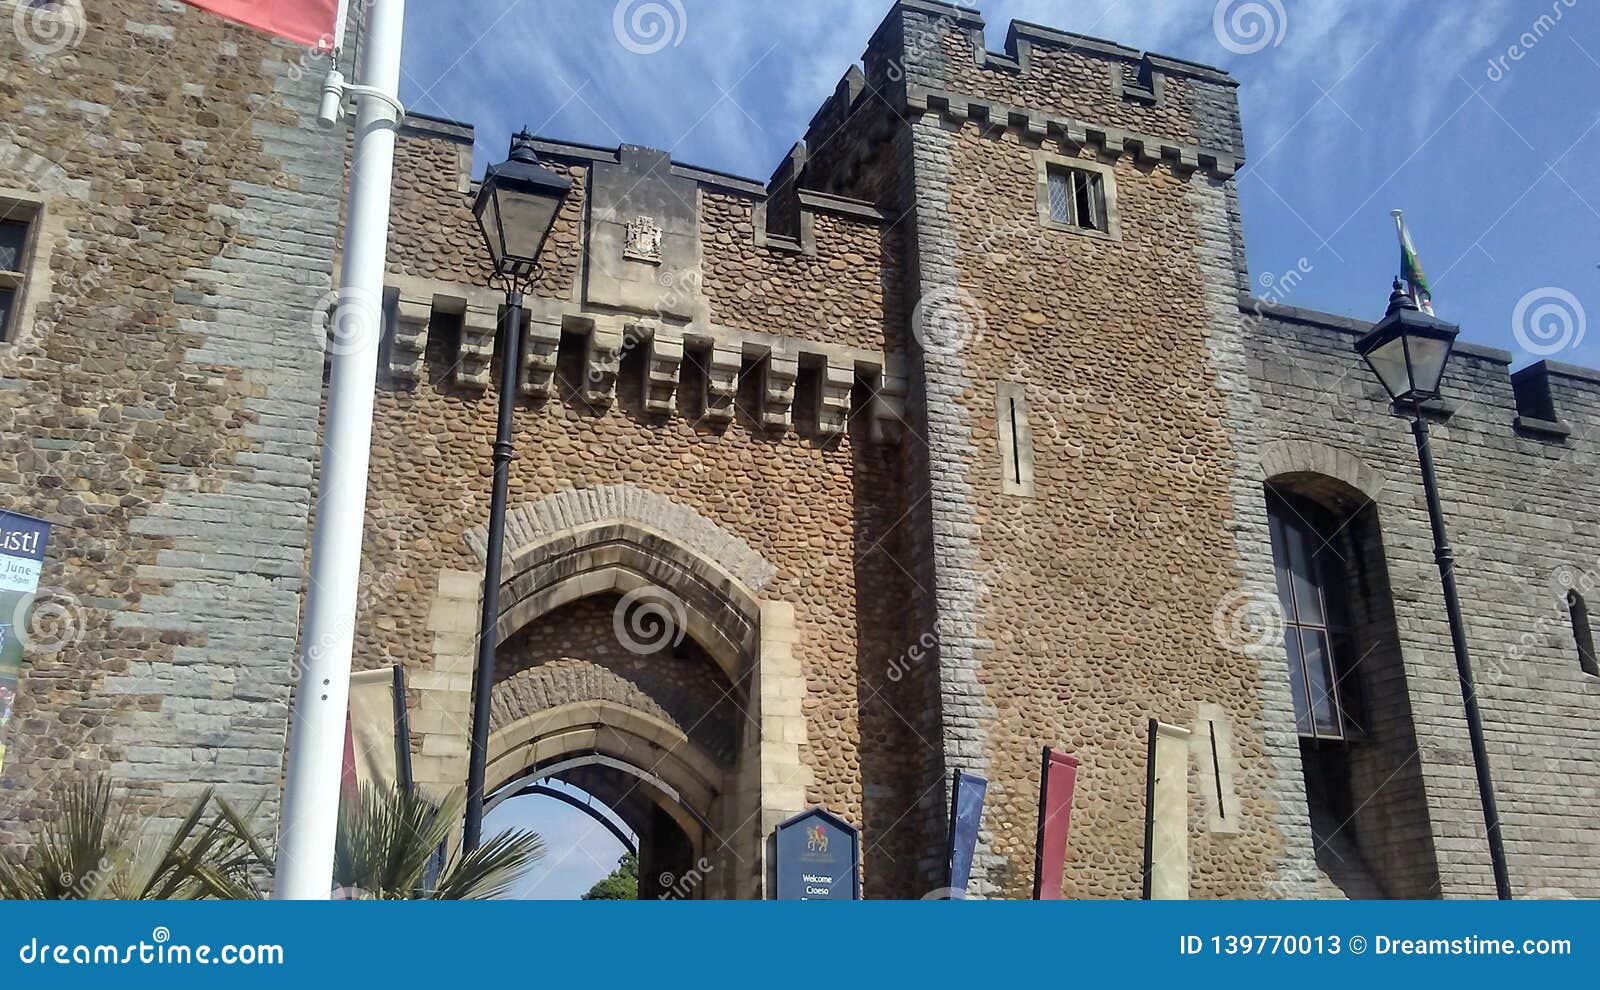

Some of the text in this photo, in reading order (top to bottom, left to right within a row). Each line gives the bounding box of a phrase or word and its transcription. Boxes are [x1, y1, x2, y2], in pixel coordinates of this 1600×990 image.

[6, 560, 32, 575] June
[802, 873, 832, 884] Welcome
[806, 885, 829, 895] Croeso
